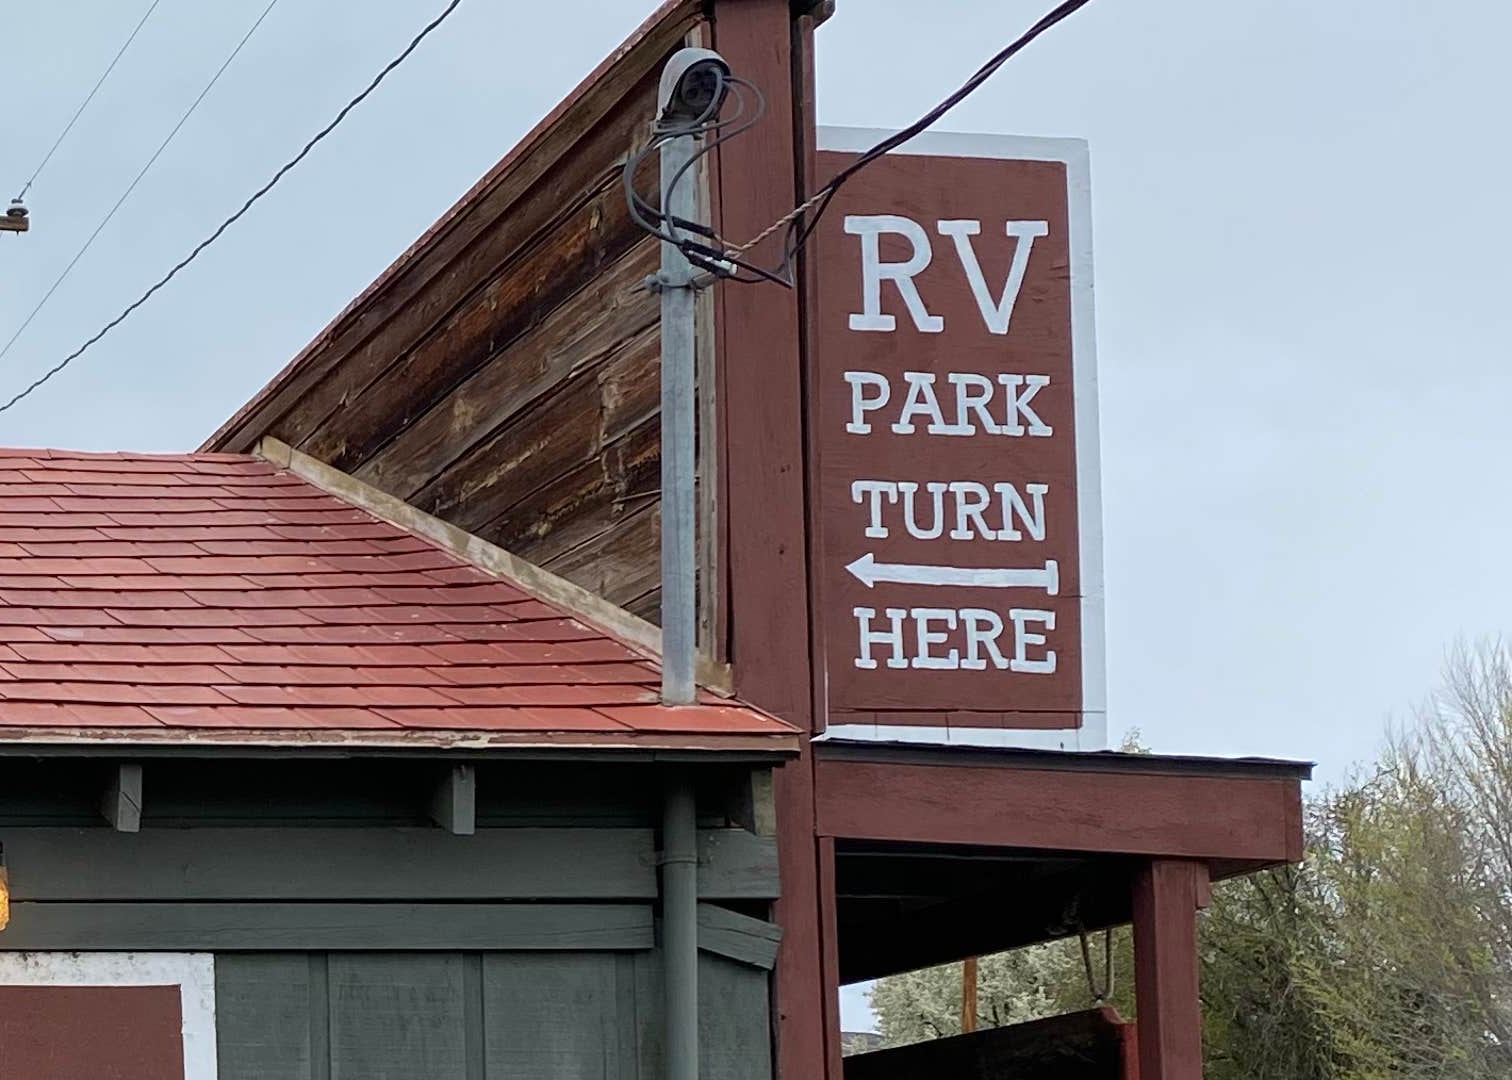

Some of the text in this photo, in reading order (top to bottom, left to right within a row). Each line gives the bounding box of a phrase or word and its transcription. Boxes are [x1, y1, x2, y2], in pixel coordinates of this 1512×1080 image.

[843, 214, 1049, 335] RV
[844, 371, 1053, 437] PARK
[851, 480, 1049, 541] TURN
[853, 607, 1057, 674] HERE
